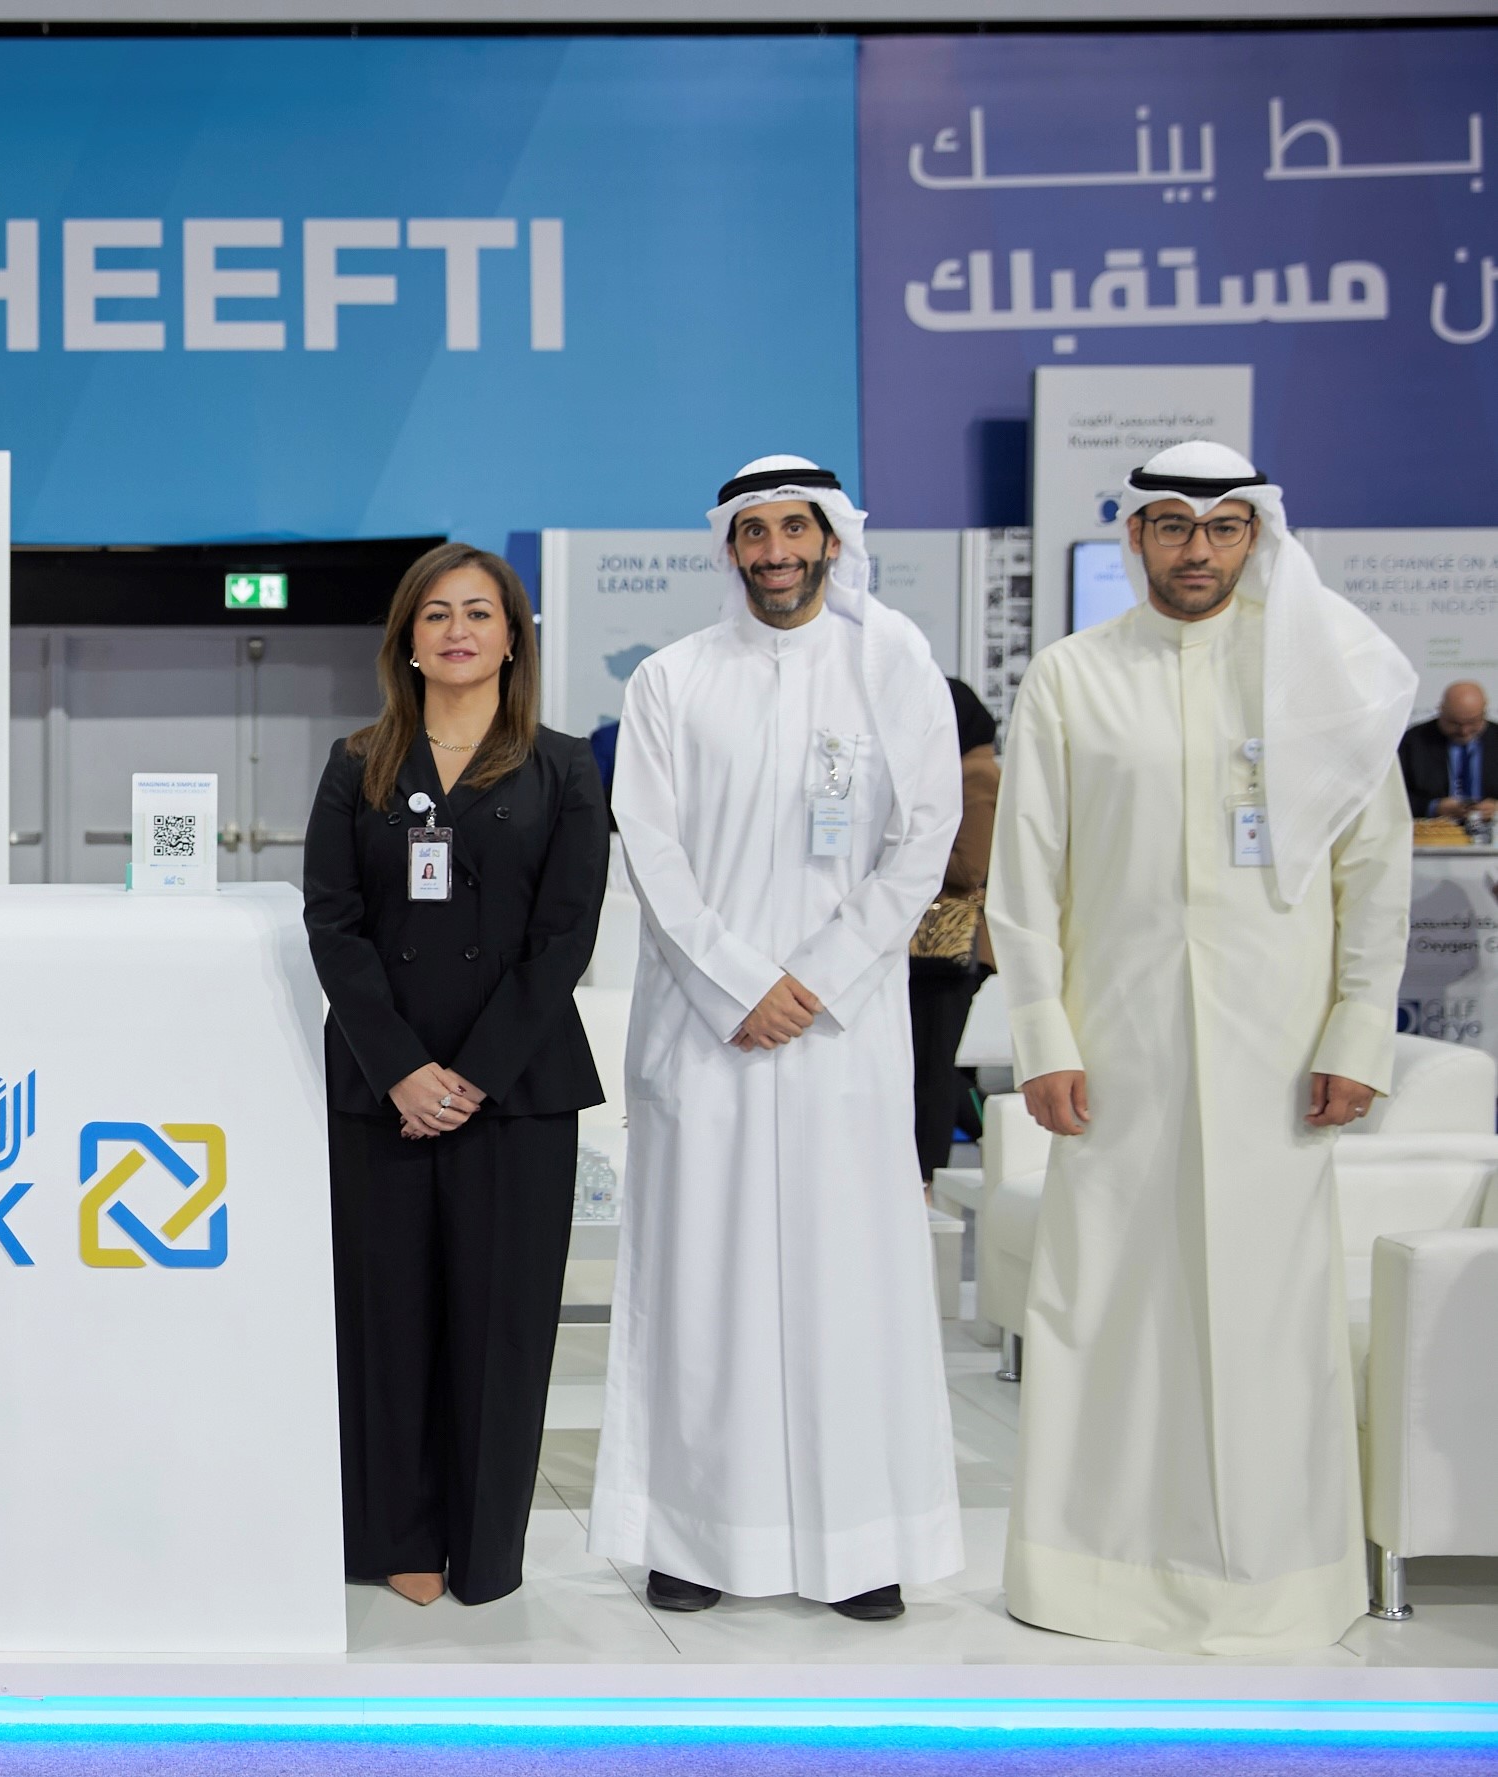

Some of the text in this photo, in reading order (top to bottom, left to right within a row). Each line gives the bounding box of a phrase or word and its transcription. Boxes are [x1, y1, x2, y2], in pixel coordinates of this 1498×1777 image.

[908, 106, 1216, 202] بينك
[905, 247, 1388, 354] مستقبلك
[597, 555, 645, 572] JOIN
[649, 555, 661, 572] A
[597, 576, 669, 594] LEADER
[1348, 597, 1382, 614] OR
